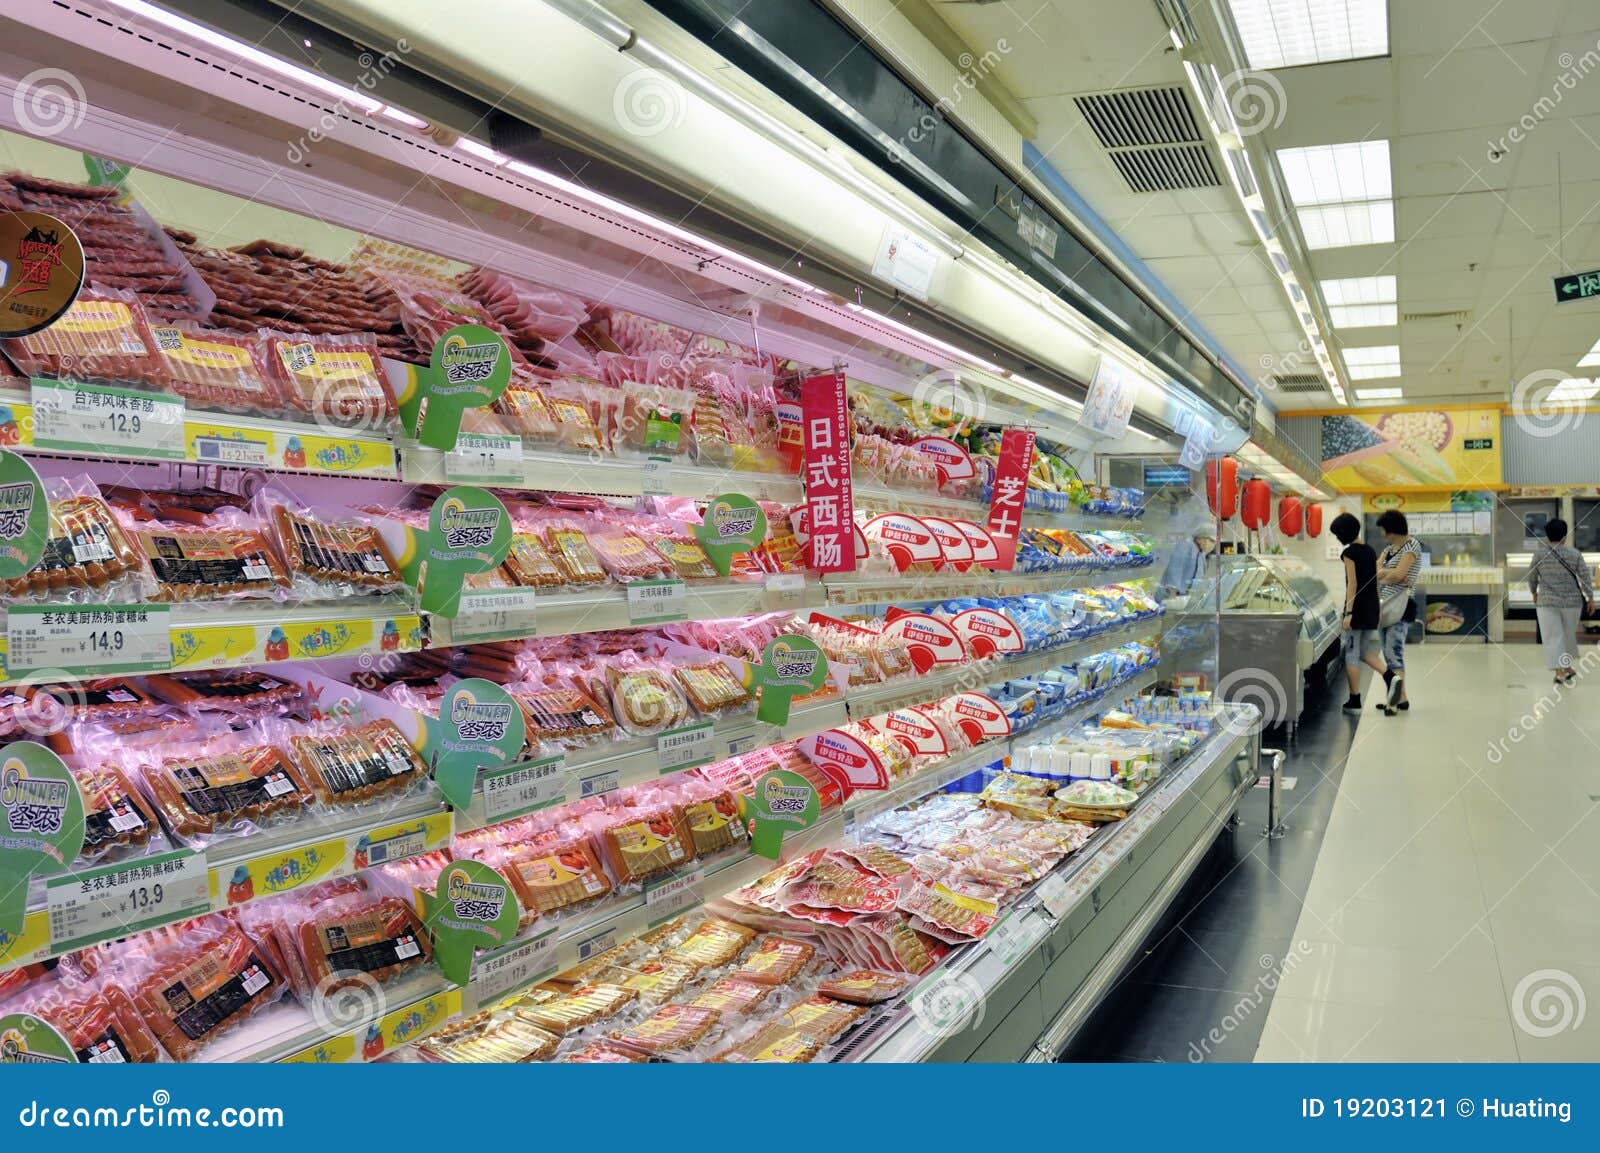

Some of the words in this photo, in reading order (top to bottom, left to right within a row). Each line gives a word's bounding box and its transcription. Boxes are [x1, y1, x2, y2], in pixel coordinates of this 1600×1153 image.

[442, 341, 500, 367] SUNNER
[449, 361, 492, 382] 圣农
[74, 389, 154, 413] 台湾风味香肠
[108, 412, 141, 434] 12.9
[839, 440, 849, 474] Style
[808, 417, 842, 567] 日式西肠
[441, 504, 500, 531] SUNNER
[991, 476, 1025, 539] 芝士
[0, 511, 26, 537] 农
[448, 527, 492, 547] 圣农
[42, 611, 149, 626] 圣农美厨热狗蜜糖味
[89, 630, 124, 651] 14.9
[452, 697, 511, 723] SUNNER
[459, 720, 505, 740] 圣农
[1, 768, 69, 808] SUNNER
[9, 805, 61, 833] 圣农
[81, 858, 186, 894] 圣农美厨热狗黑椒味
[129, 883, 164, 910] 13.9
[448, 875, 505, 905] SUNNER
[455, 900, 500, 920] 圣农
